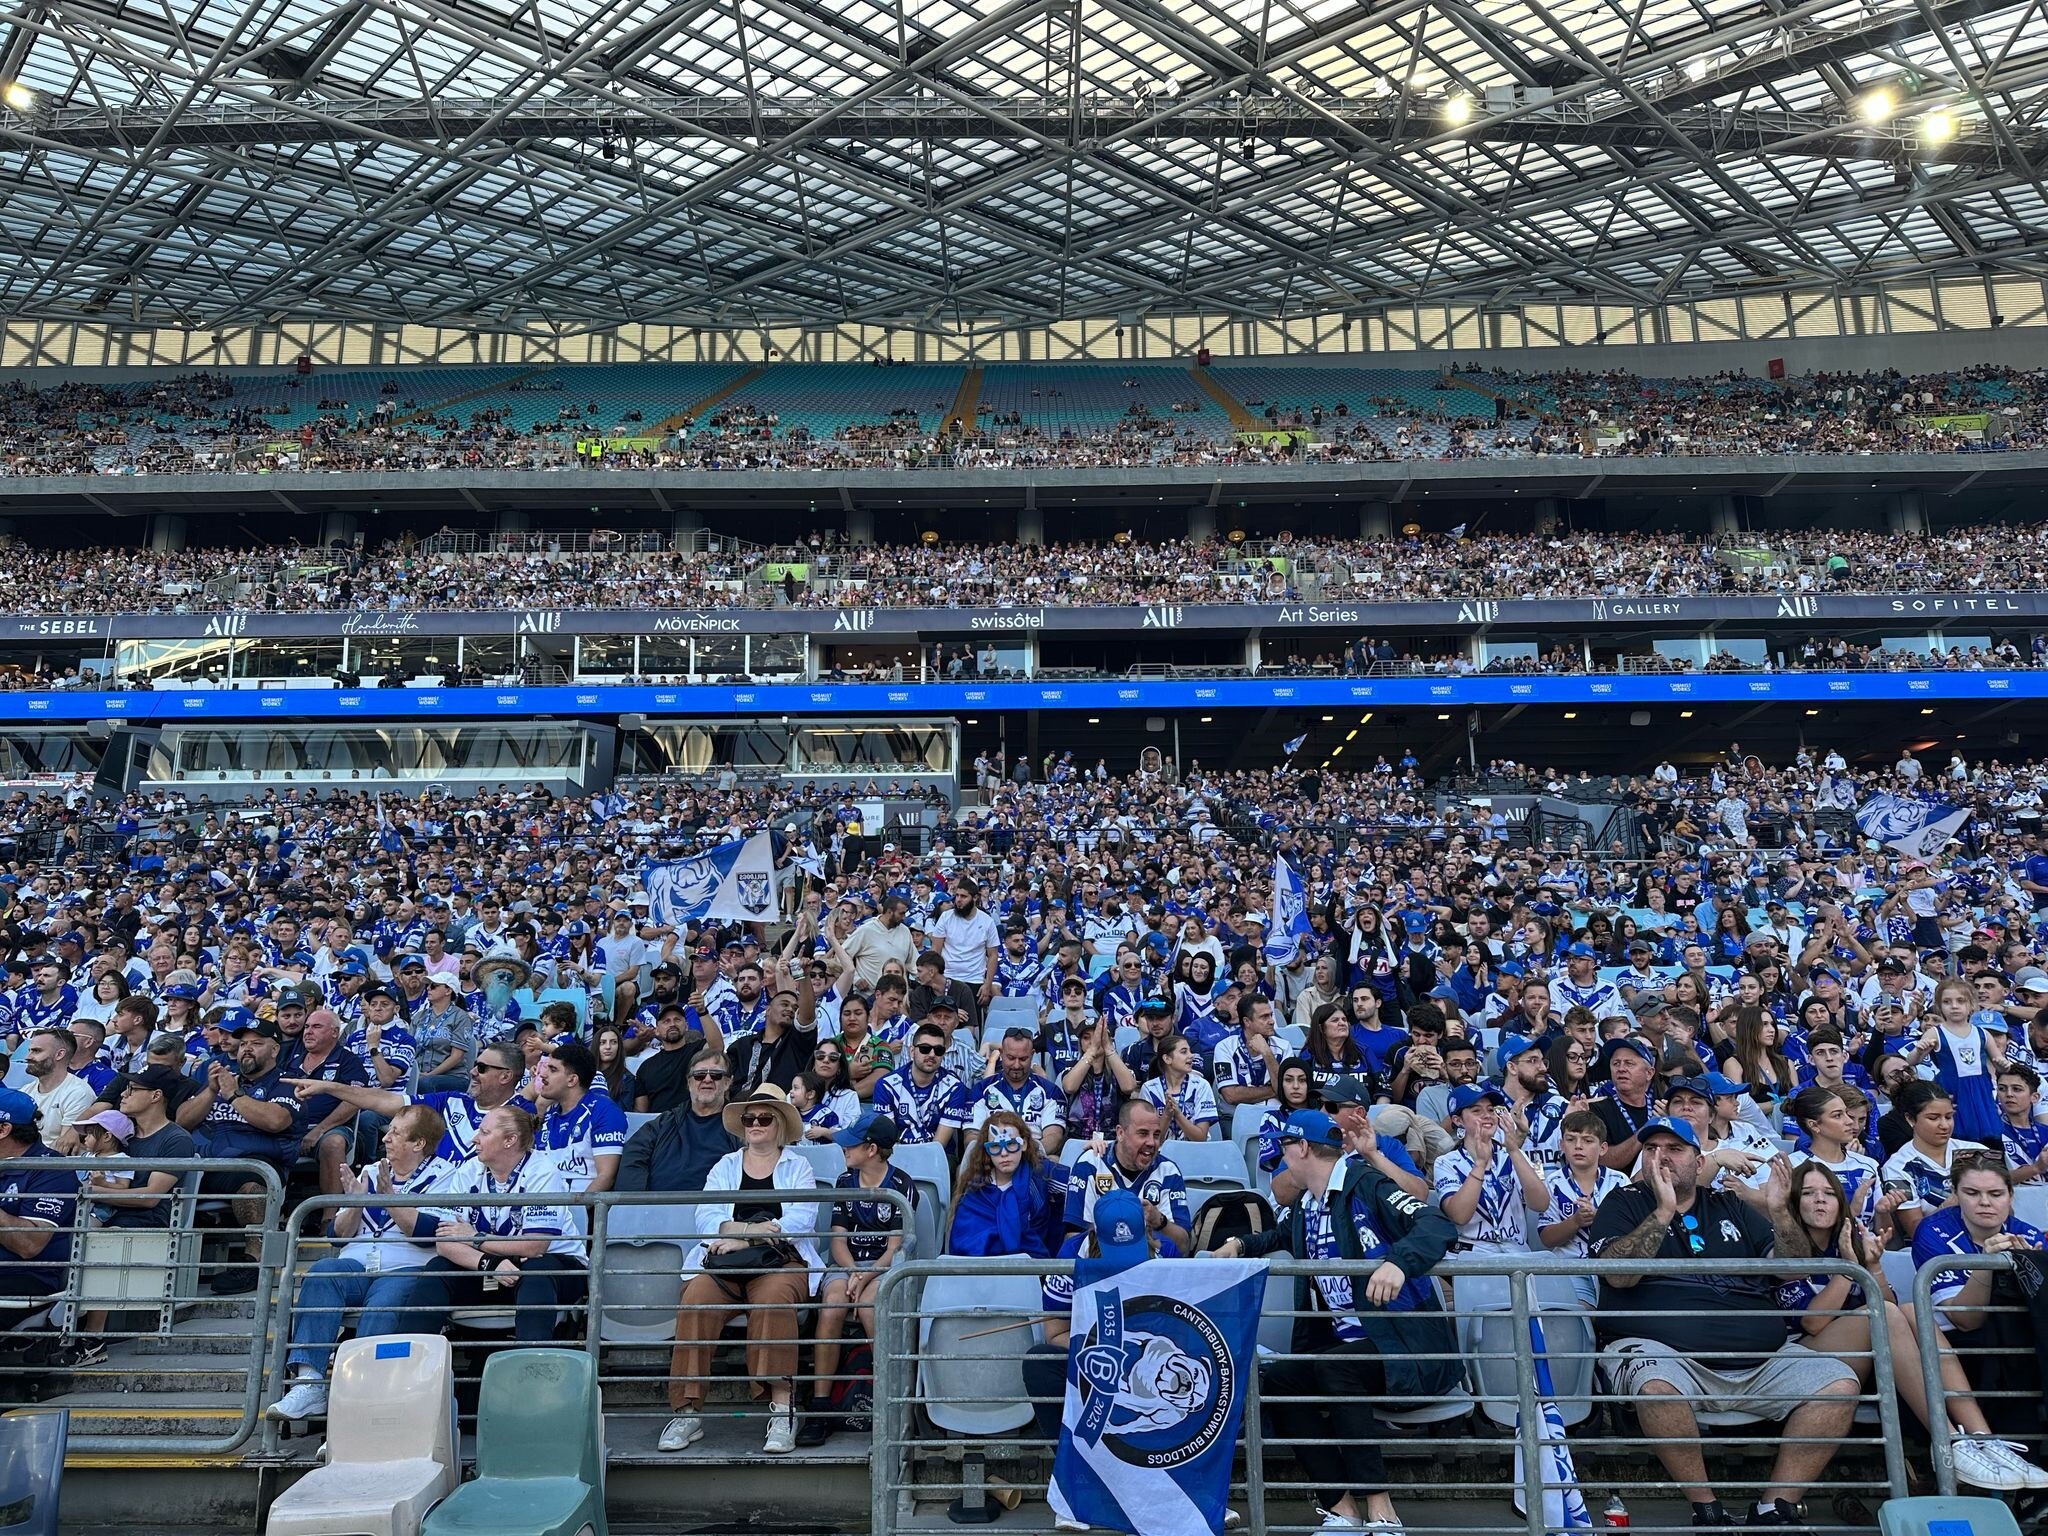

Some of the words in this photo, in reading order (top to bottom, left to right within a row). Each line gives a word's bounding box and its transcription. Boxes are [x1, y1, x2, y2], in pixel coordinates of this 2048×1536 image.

[1278, 607, 1303, 622] Art
[1309, 606, 1358, 622] Series
[1457, 601, 1492, 622] All
[1613, 603, 1680, 615] GALLERY
[1777, 597, 1811, 617] All
[1891, 599, 2019, 611] SOFITEL
[203, 616, 238, 636] All
[342, 613, 419, 635] Handwritten
[518, 612, 552, 632] All
[654, 614, 740, 631] MÖVENPICK
[833, 610, 866, 631] All
[971, 609, 1044, 629] swissôtel
[1140, 607, 1175, 627] All
[39, 620, 97, 635] SEBEL
[595, 1131, 625, 1144] watty
[1103, 1302, 1116, 1337] 1935
[1173, 1304, 1230, 1438] CANTERBURY-BANKSTOWN
[1086, 1396, 1105, 1431] 2025
[1147, 1434, 1205, 1464] BULLDOGS
